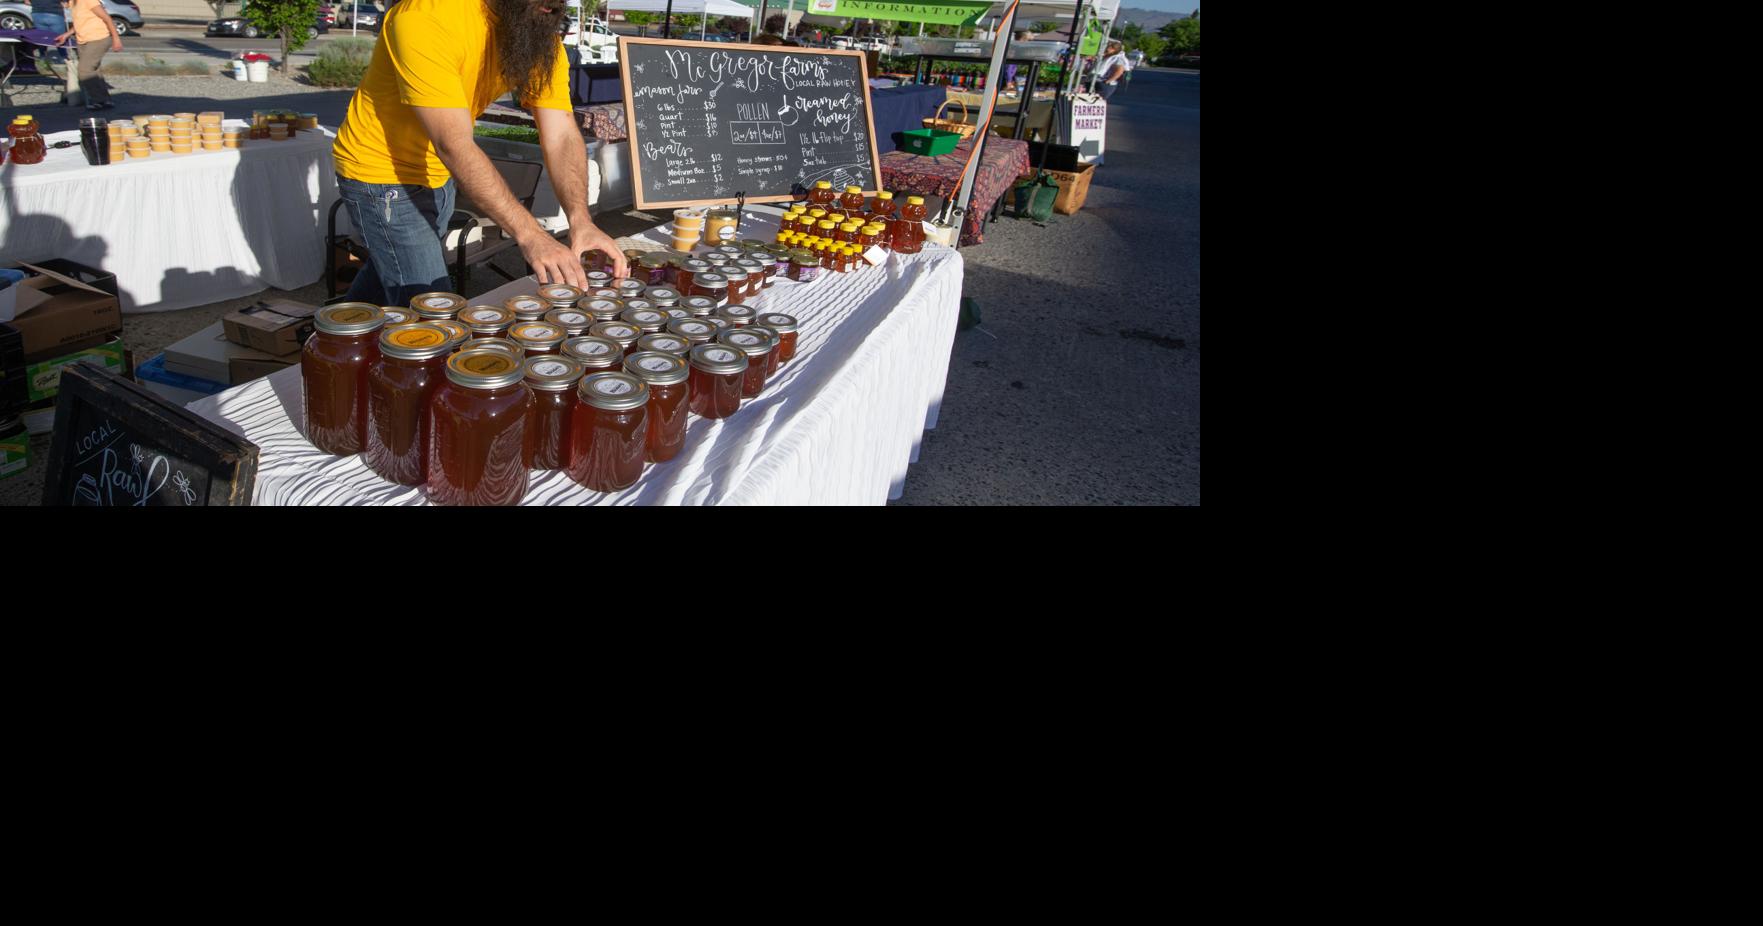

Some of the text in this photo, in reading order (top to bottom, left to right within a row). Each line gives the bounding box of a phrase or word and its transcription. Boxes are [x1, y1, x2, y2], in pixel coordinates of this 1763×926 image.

[842, 1, 979, 17] INFORMATION
[709, 51, 777, 92] Gregor
[816, 79, 831, 87] RAW
[833, 79, 856, 88] HONEY
[736, 102, 770, 120] POLLEN
[795, 92, 852, 112] creamed
[1074, 105, 1105, 116] FARMERS
[813, 107, 857, 134] honey
[1075, 119, 1102, 129] MARKET
[643, 139, 693, 160] Bears
[76, 419, 116, 455] LOCAL
